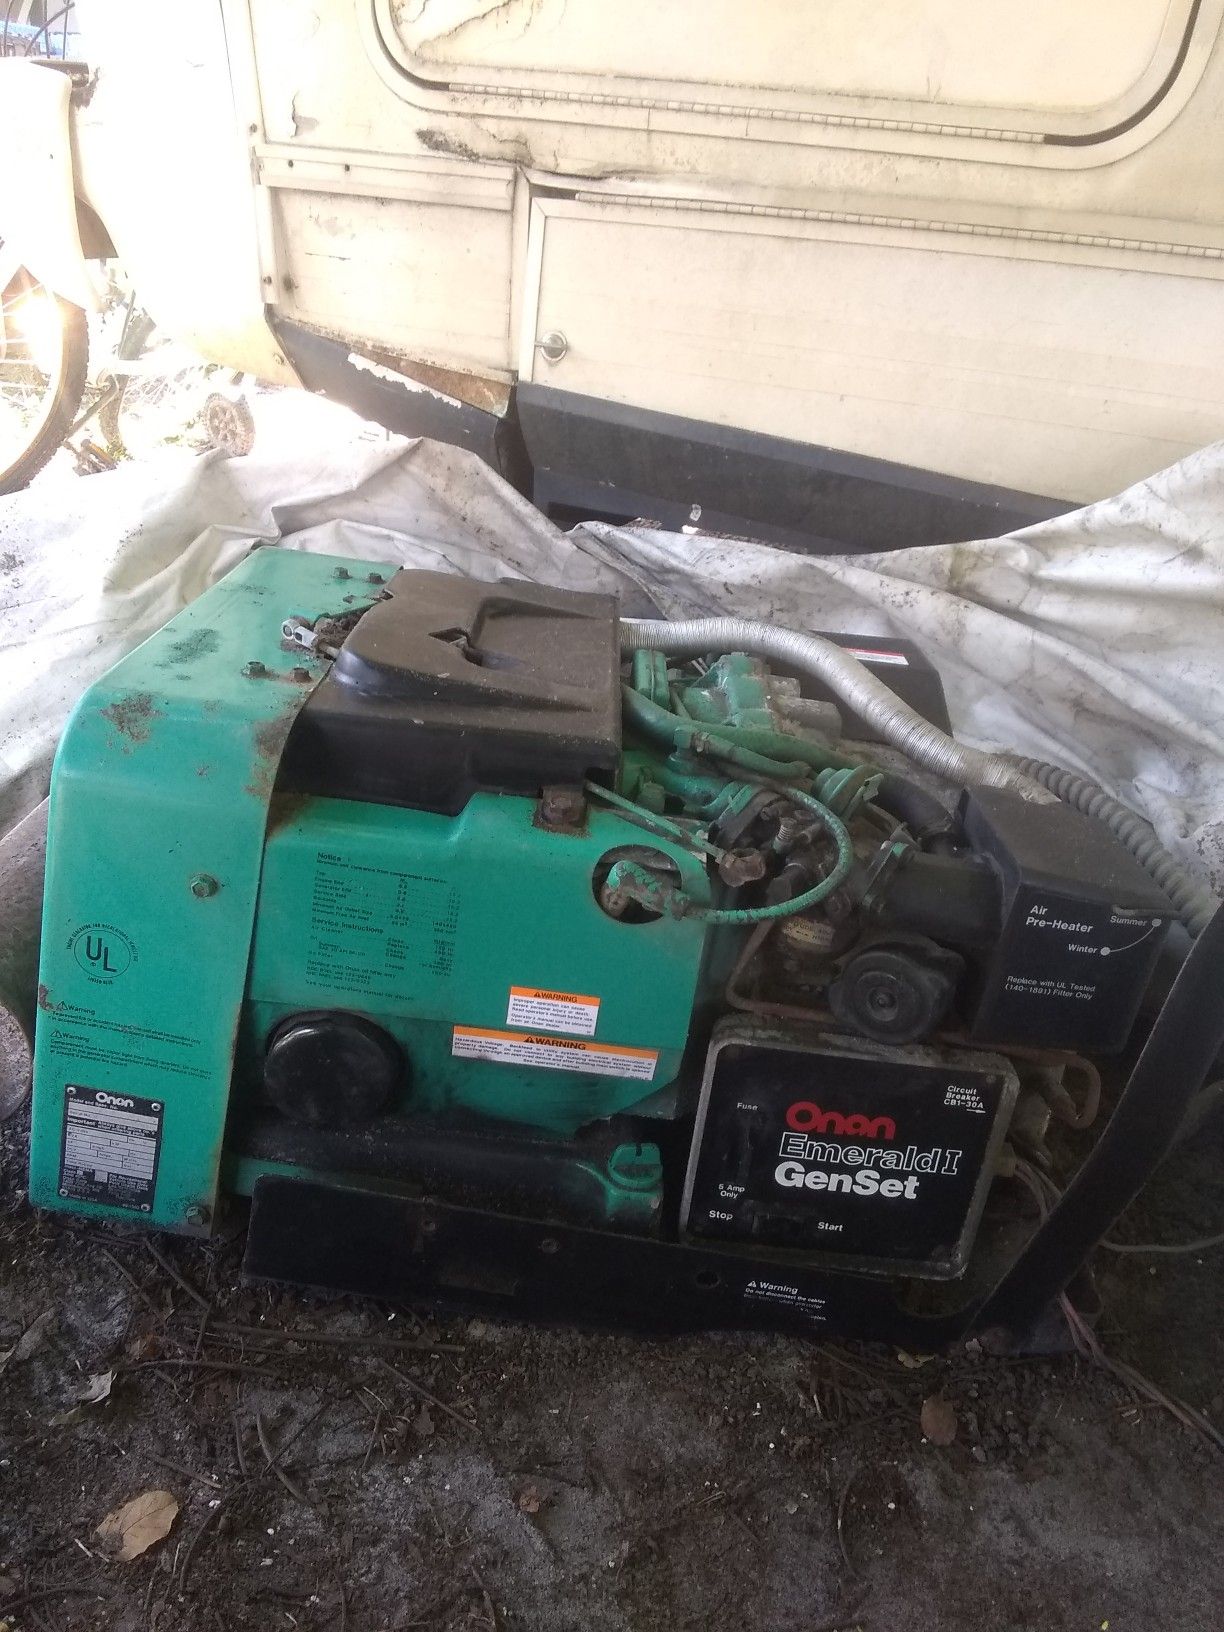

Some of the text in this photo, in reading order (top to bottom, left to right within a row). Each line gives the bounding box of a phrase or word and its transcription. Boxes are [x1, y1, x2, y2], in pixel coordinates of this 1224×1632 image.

[318, 852, 341, 861] Notice
[1030, 905, 1048, 915] Air
[312, 917, 384, 934] Service Instructions
[1026, 917, 1093, 932] Pre-Heater
[1110, 916, 1147, 926] Summer
[86, 936, 118, 973] UL
[1068, 944, 1097, 954] Winter
[1007, 976, 1037, 986] Replace
[1057, 981, 1066, 989] UL
[1070, 983, 1096, 992] Tested
[540, 992, 577, 1003] WARNING
[1053, 989, 1073, 998] Filter
[1076, 992, 1093, 1000] Only
[68, 1004, 95, 1016] Warning
[62, 1033, 90, 1042] Warning
[535, 1037, 586, 1050] WARNING
[947, 1085, 977, 1094] Circuit
[96, 1092, 134, 1107] Onan
[945, 1092, 980, 1101] Breaker
[737, 1102, 758, 1111] Fuse
[943, 1098, 984, 1109] CB1-30A
[786, 1100, 896, 1140] Onan
[778, 1131, 962, 1175] Emerald I
[774, 1161, 920, 1199] GenSet
[726, 1184, 745, 1193] Amp
[720, 1190, 738, 1199] Only
[709, 1210, 733, 1221] Stop
[818, 1221, 843, 1232] Start
[760, 1281, 798, 1294] Warning
